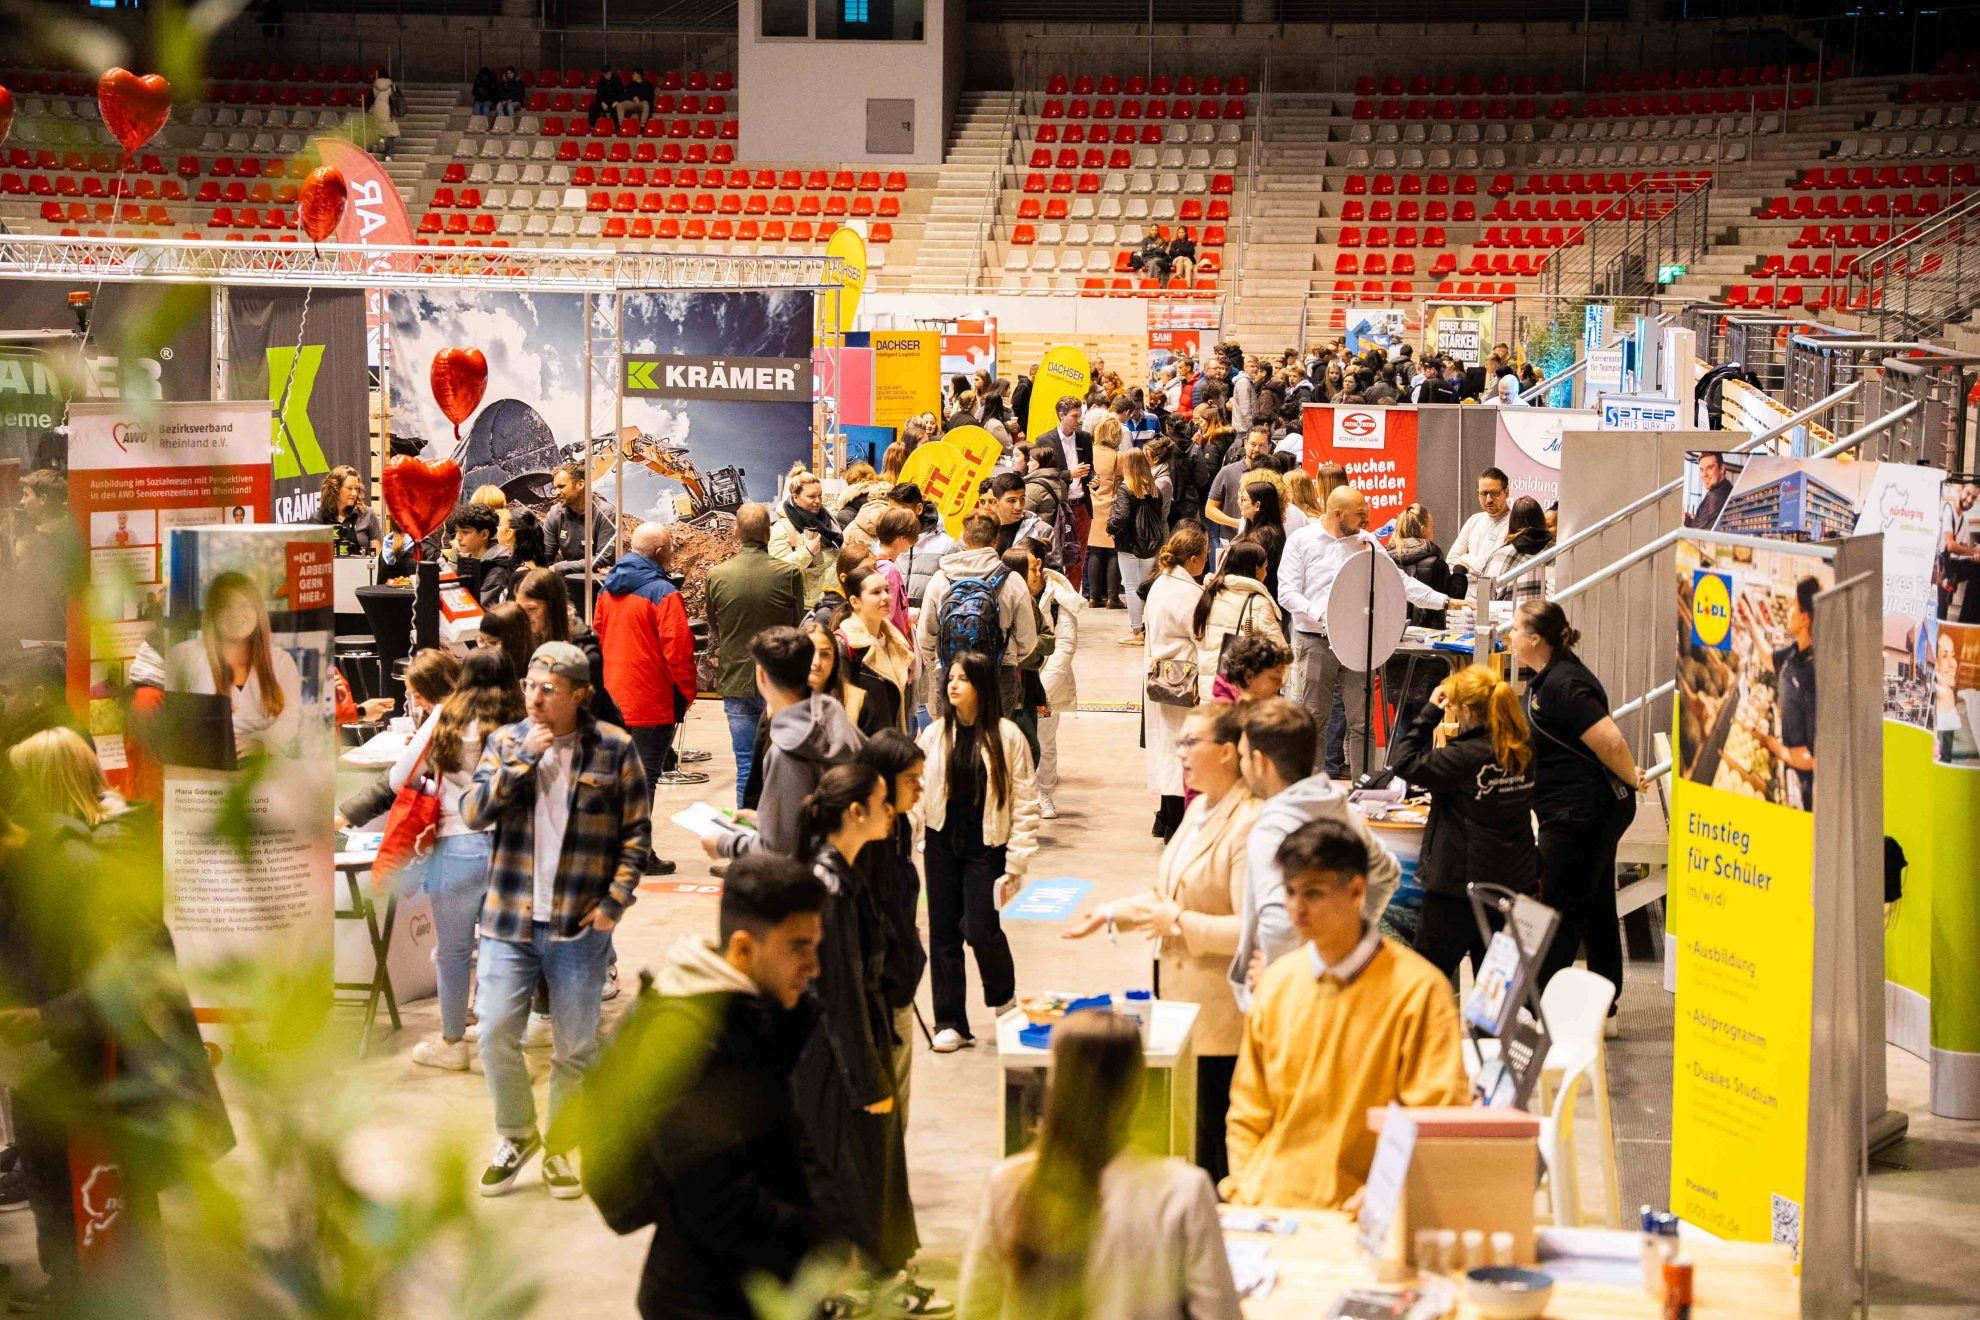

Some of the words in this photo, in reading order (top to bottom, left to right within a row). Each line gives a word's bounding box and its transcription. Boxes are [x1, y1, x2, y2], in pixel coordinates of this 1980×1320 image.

[876, 340, 920, 350] DACHSER
[1152, 333, 1172, 341] SANI
[1438, 331, 1479, 348] STÄRKEN
[1047, 361, 1085, 382] DACHSER
[159, 423, 233, 434] Bezirksverband
[159, 438, 209, 448] Rheinland
[212, 437, 229, 448] e.V.
[1345, 457, 1395, 474] suchen
[90, 479, 134, 489] Ausbildung
[135, 479, 145, 487] im
[146, 477, 193, 486] Sozialwesen
[194, 476, 208, 484] mit
[1348, 474, 1406, 490] ehelden
[1508, 476, 1558, 498] usbildung
[90, 491, 99, 499] in
[101, 490, 116, 499] den
[118, 490, 134, 498] AWO
[136, 487, 199, 498] Seniorenzentren
[201, 487, 211, 496] im
[1364, 491, 1403, 509] rgen!
[275, 488, 321, 524] KRÄME
[299, 562, 332, 576] ARBEITE
[299, 578, 323, 590] GERN
[1688, 812, 1750, 854] Einstieg
[1687, 848, 1710, 874] für
[1713, 853, 1773, 892] Schüler
[1692, 941, 1756, 979] Ausbildung
[1692, 1008, 1767, 1049] Abiprogramm
[1692, 1061, 1731, 1092] Duales
[1733, 1076, 1778, 1111] Studium
